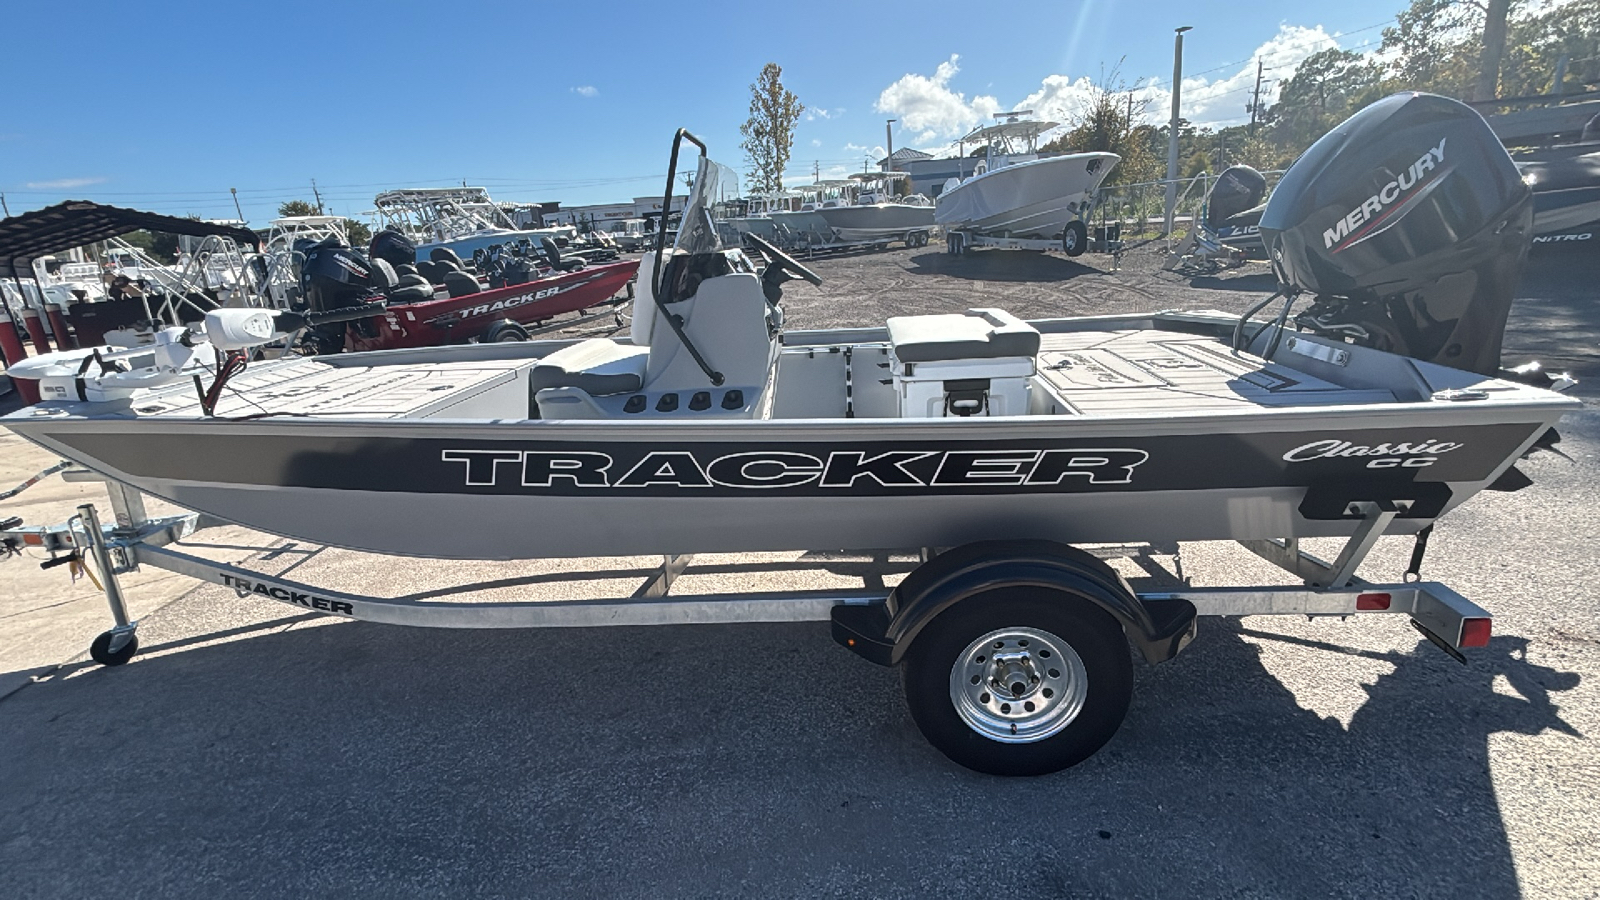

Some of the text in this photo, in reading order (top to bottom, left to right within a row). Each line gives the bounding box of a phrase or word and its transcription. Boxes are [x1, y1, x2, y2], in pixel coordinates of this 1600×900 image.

[1322, 137, 1447, 249] MERCURY
[1532, 232, 1593, 243] NITRO
[459, 286, 560, 319] TRACKER
[1282, 439, 1465, 463] Classic
[1366, 457, 1438, 468] CC
[441, 448, 1149, 489] TRACKER
[219, 573, 354, 615] TRACKER
